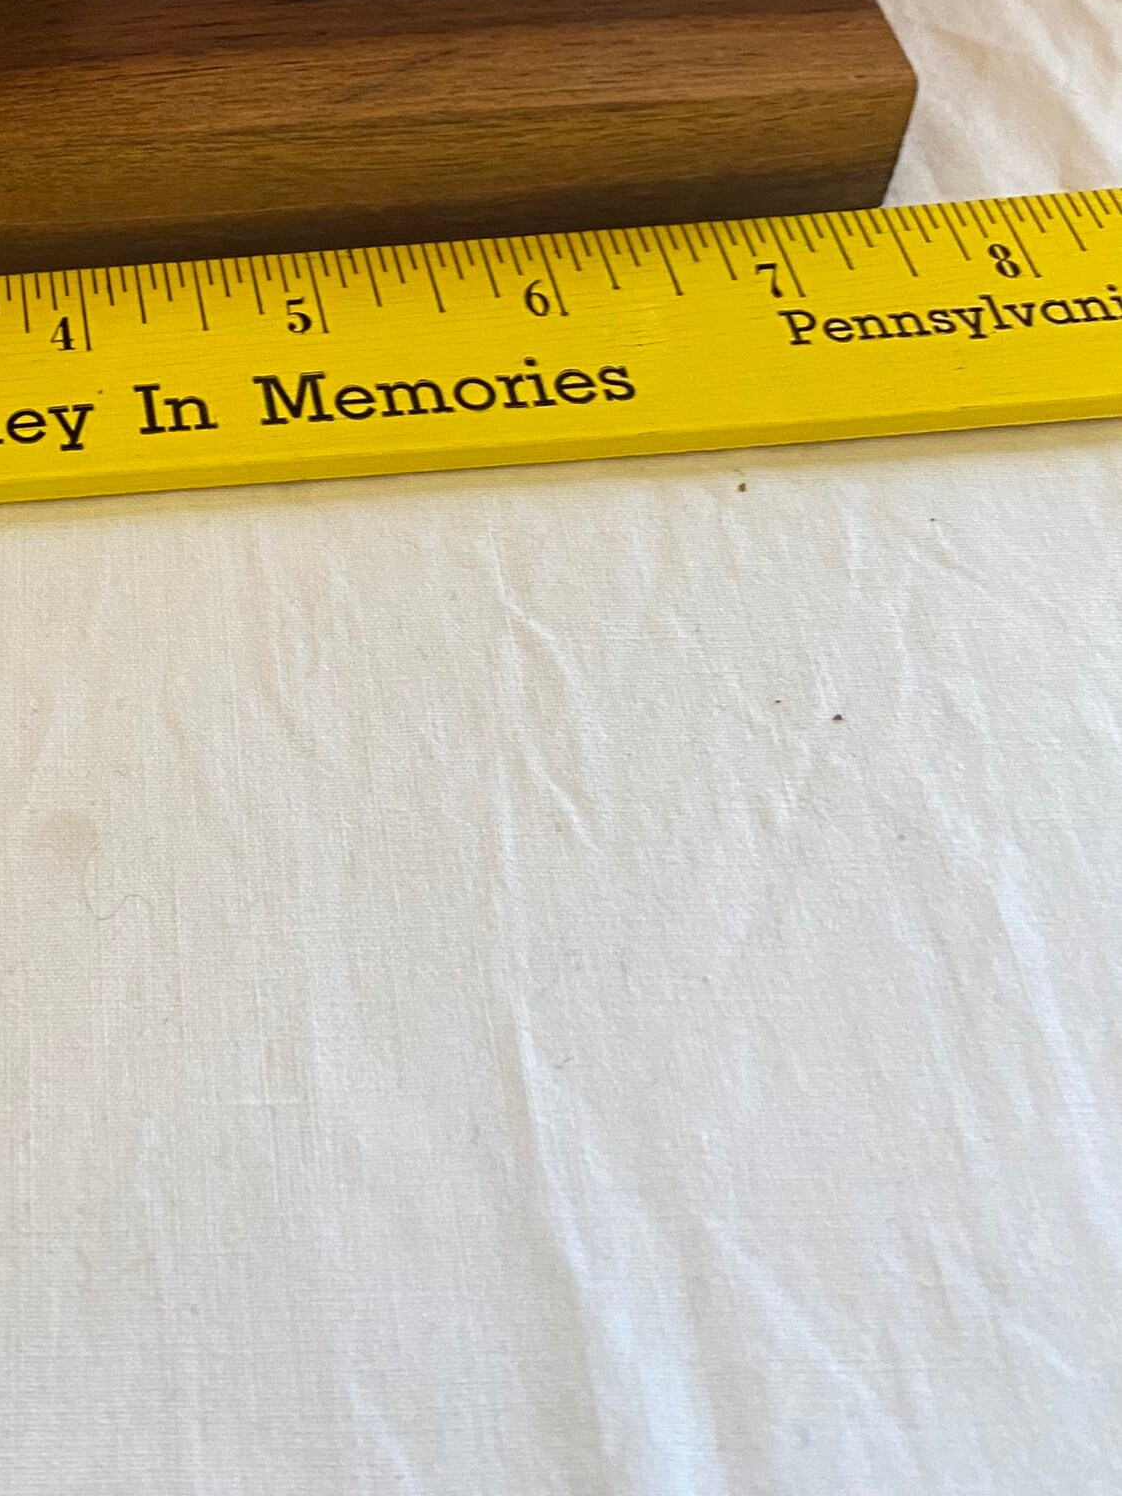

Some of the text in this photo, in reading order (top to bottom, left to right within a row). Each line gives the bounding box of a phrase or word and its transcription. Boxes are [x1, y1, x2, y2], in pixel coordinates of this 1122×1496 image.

[50, 316, 77, 352] 4
[286, 298, 313, 335] 5
[524, 279, 551, 317] 6
[754, 263, 783, 299] 7
[987, 244, 1020, 278] 8
[134, 384, 218, 435] In
[253, 357, 636, 426] Memories
